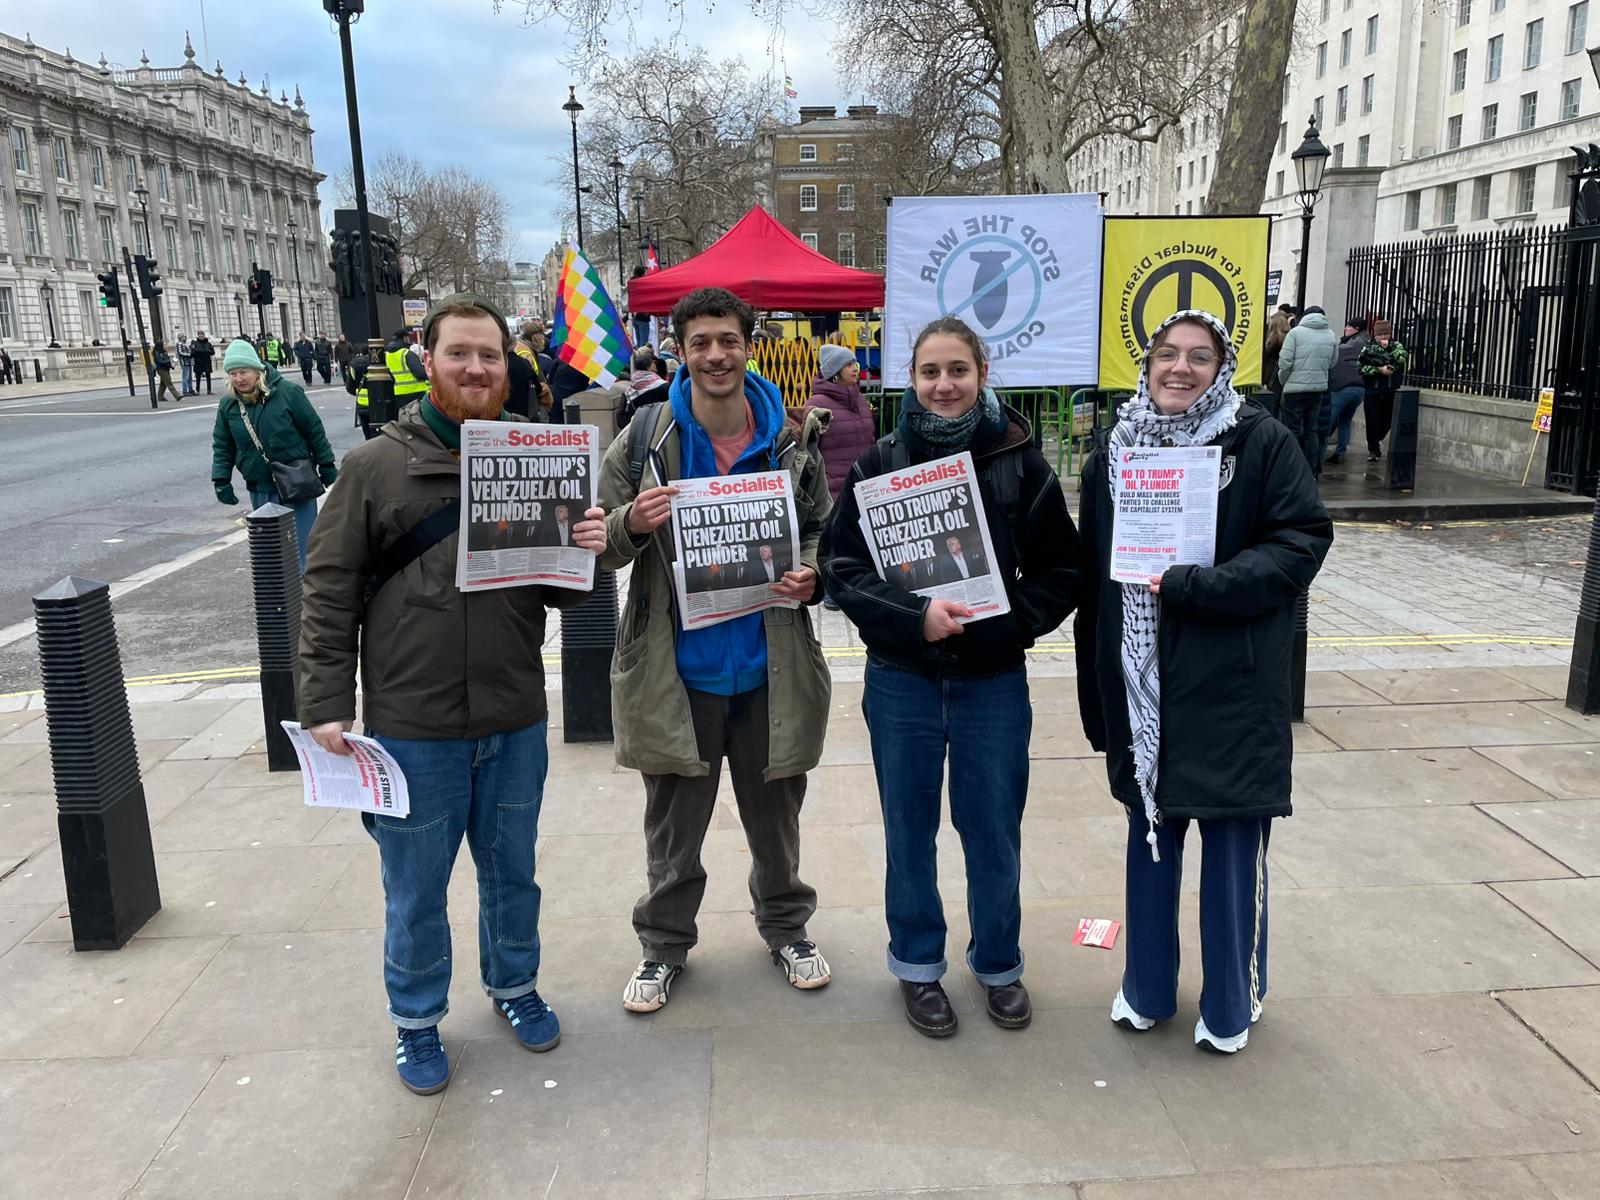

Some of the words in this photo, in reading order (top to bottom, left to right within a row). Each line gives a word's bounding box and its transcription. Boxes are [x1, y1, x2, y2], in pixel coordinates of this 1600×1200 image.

[493, 437, 508, 447] the
[508, 430, 590, 447] Socialist
[472, 457, 495, 479] NO
[497, 457, 517, 478] TO
[519, 456, 586, 478] TRUMP'S
[890, 459, 966, 492] Socialist
[1121, 469, 1133, 479] NO
[1135, 469, 1145, 479] TO
[1148, 468, 1184, 479] TRUMP'S
[471, 480, 556, 501] VENEZUELA
[559, 479, 583, 500] OIL
[709, 475, 785, 496] Socialist
[1125, 480, 1137, 490] OIL
[1140, 480, 1179, 490] PLUNDER!
[472, 500, 542, 523] PLUNDER
[680, 506, 700, 528] NO
[701, 503, 720, 525] TO
[721, 499, 784, 523] TRUMP'S
[869, 506, 889, 528] NO
[887, 501, 905, 524] TO
[903, 486, 968, 520] TRUMP'S
[682, 524, 760, 548] VENEZUELA
[760, 519, 783, 540] OIL
[873, 514, 945, 548] VENEZUELA
[944, 508, 969, 532] OIL
[685, 544, 748, 569] PLUNDER
[879, 539, 936, 568] PLUNDER
[375, 760, 388, 776] THE
[381, 776, 393, 808] STRIKE!
